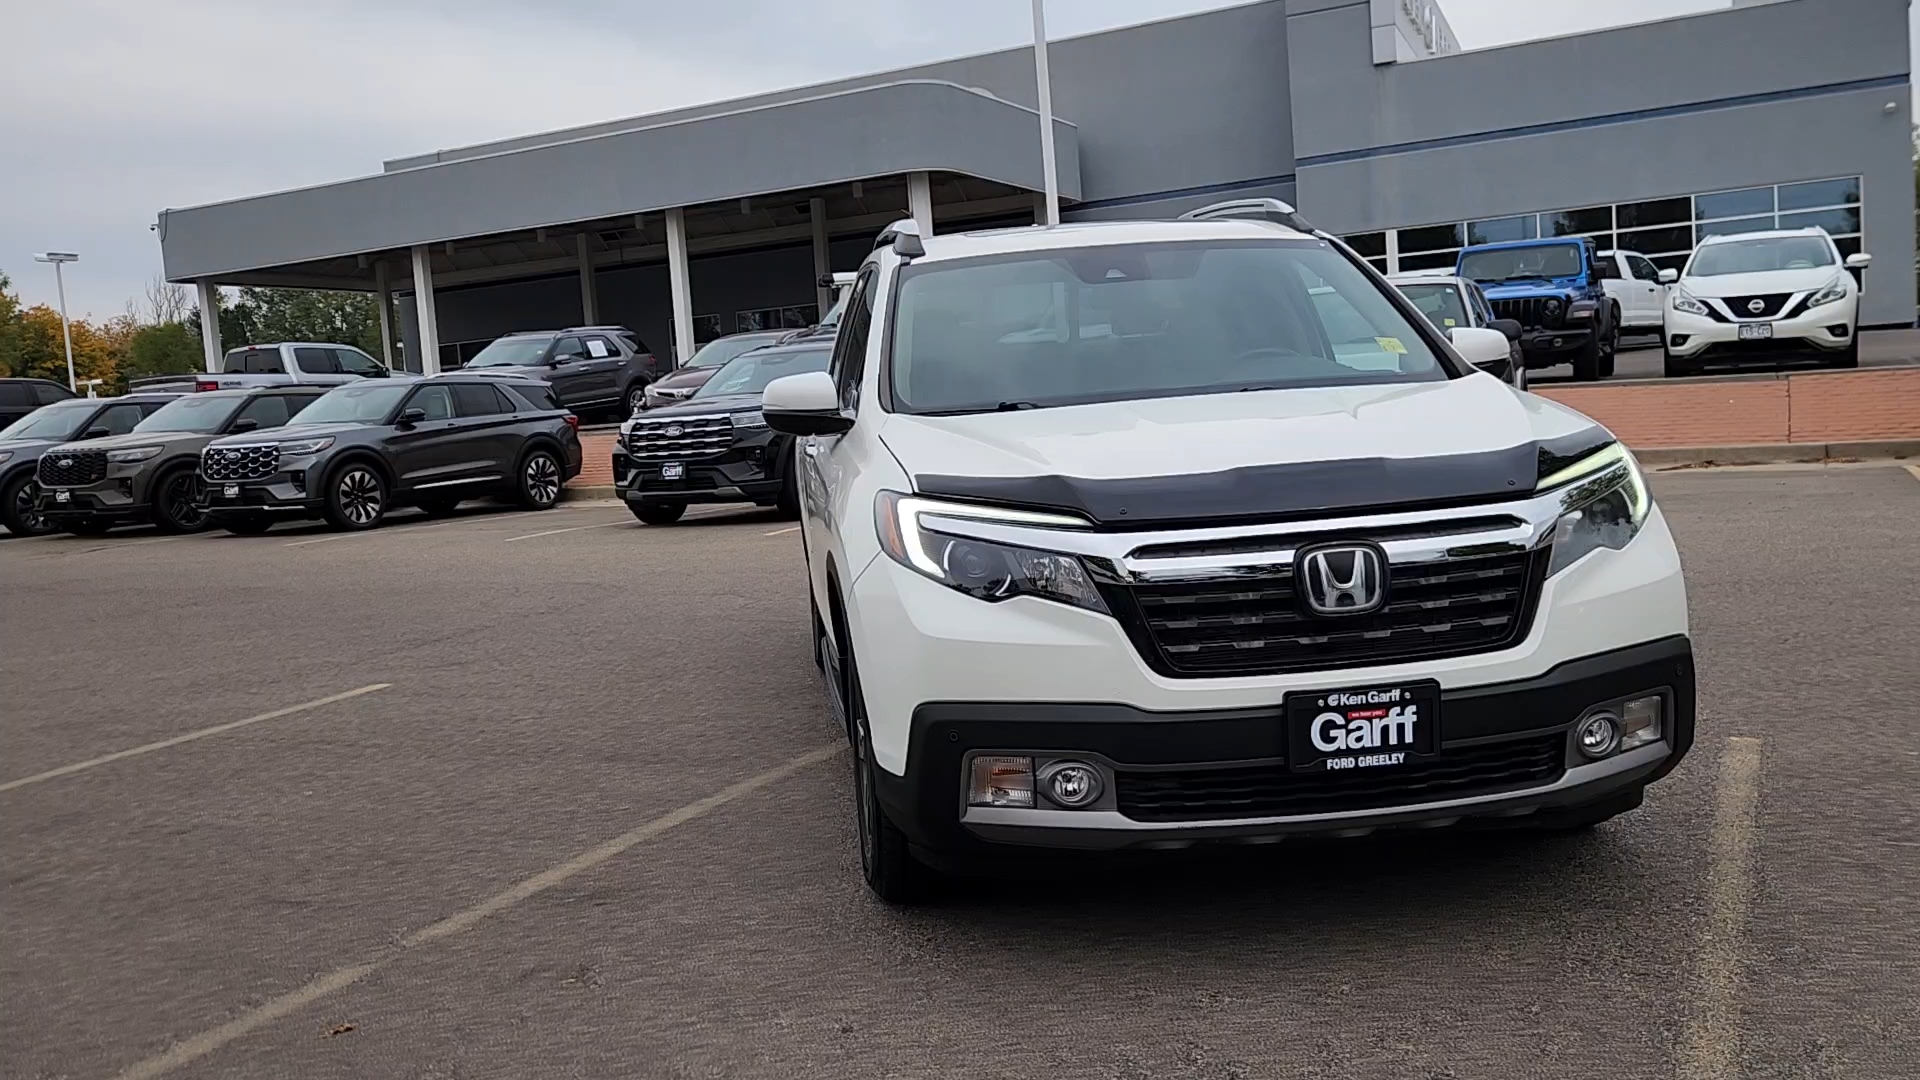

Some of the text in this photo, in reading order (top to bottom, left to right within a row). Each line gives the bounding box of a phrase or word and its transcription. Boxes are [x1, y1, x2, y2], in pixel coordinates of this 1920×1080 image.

[1340, 689, 1401, 706] Ken Garff
[1310, 705, 1417, 752] Garff
[1327, 753, 1405, 770] FORD GREELEY
